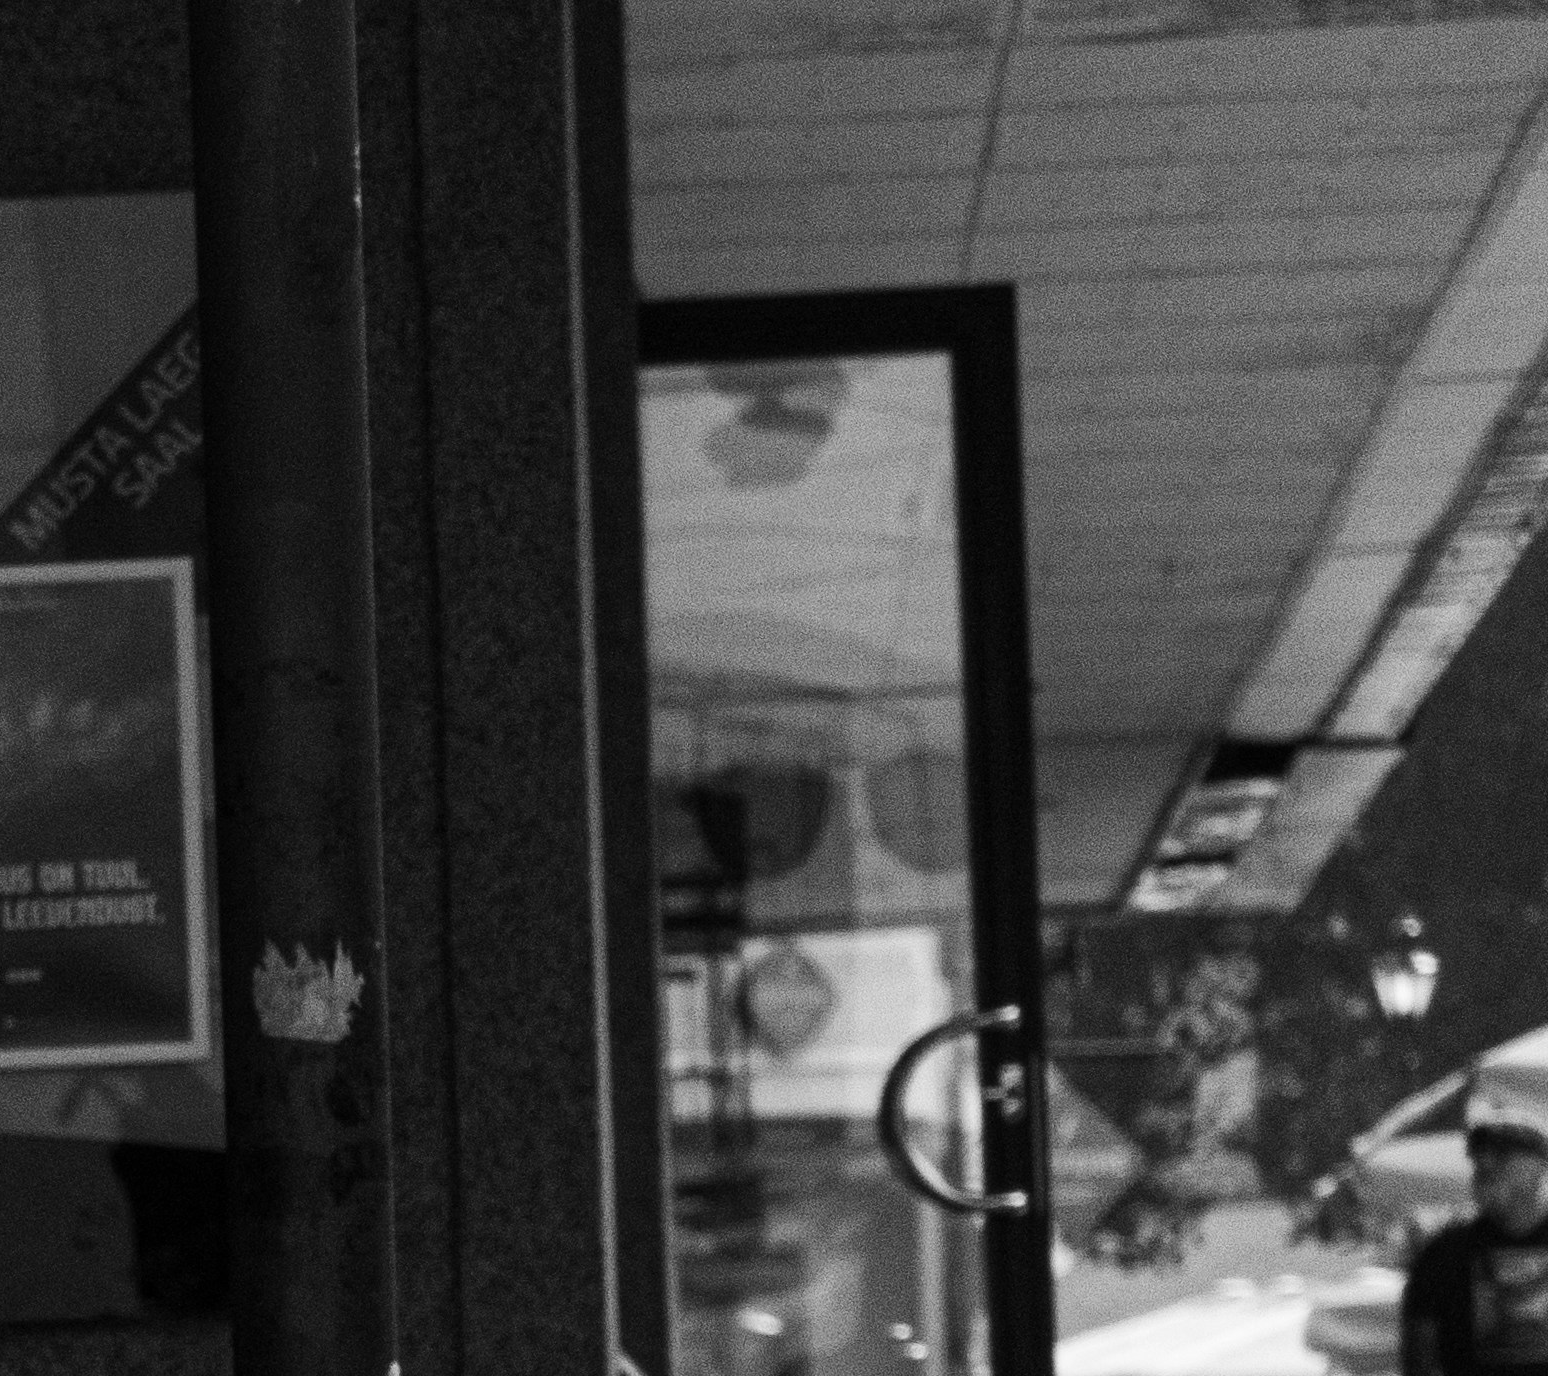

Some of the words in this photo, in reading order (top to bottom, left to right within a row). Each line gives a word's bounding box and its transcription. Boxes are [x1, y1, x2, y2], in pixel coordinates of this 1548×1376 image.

[10, 423, 137, 550] MUSTA
[113, 329, 202, 434] LAEG
[110, 414, 203, 511] SAAL
[38, 861, 75, 893] ON
